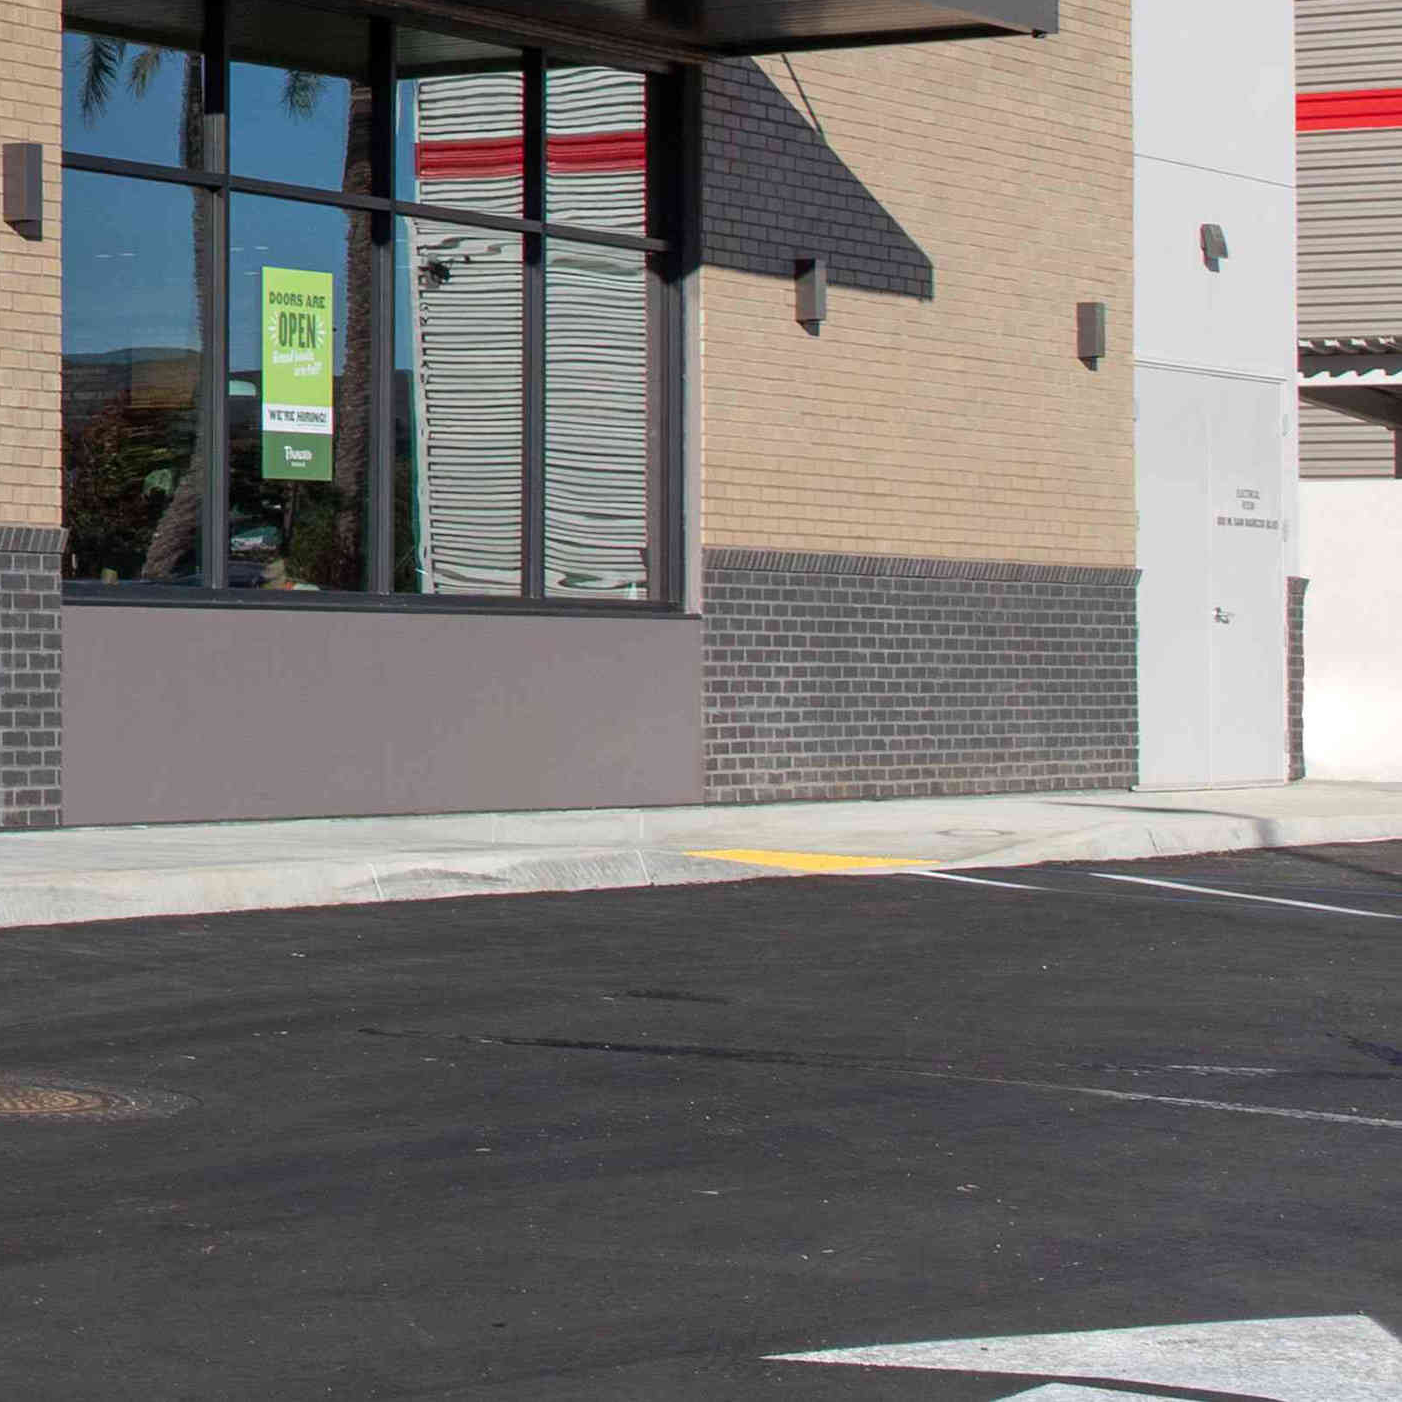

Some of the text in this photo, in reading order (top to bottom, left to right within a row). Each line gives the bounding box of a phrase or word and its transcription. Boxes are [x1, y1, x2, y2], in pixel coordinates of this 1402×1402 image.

[269, 291, 326, 309] DOORS ARE
[278, 309, 317, 349] OPEN
